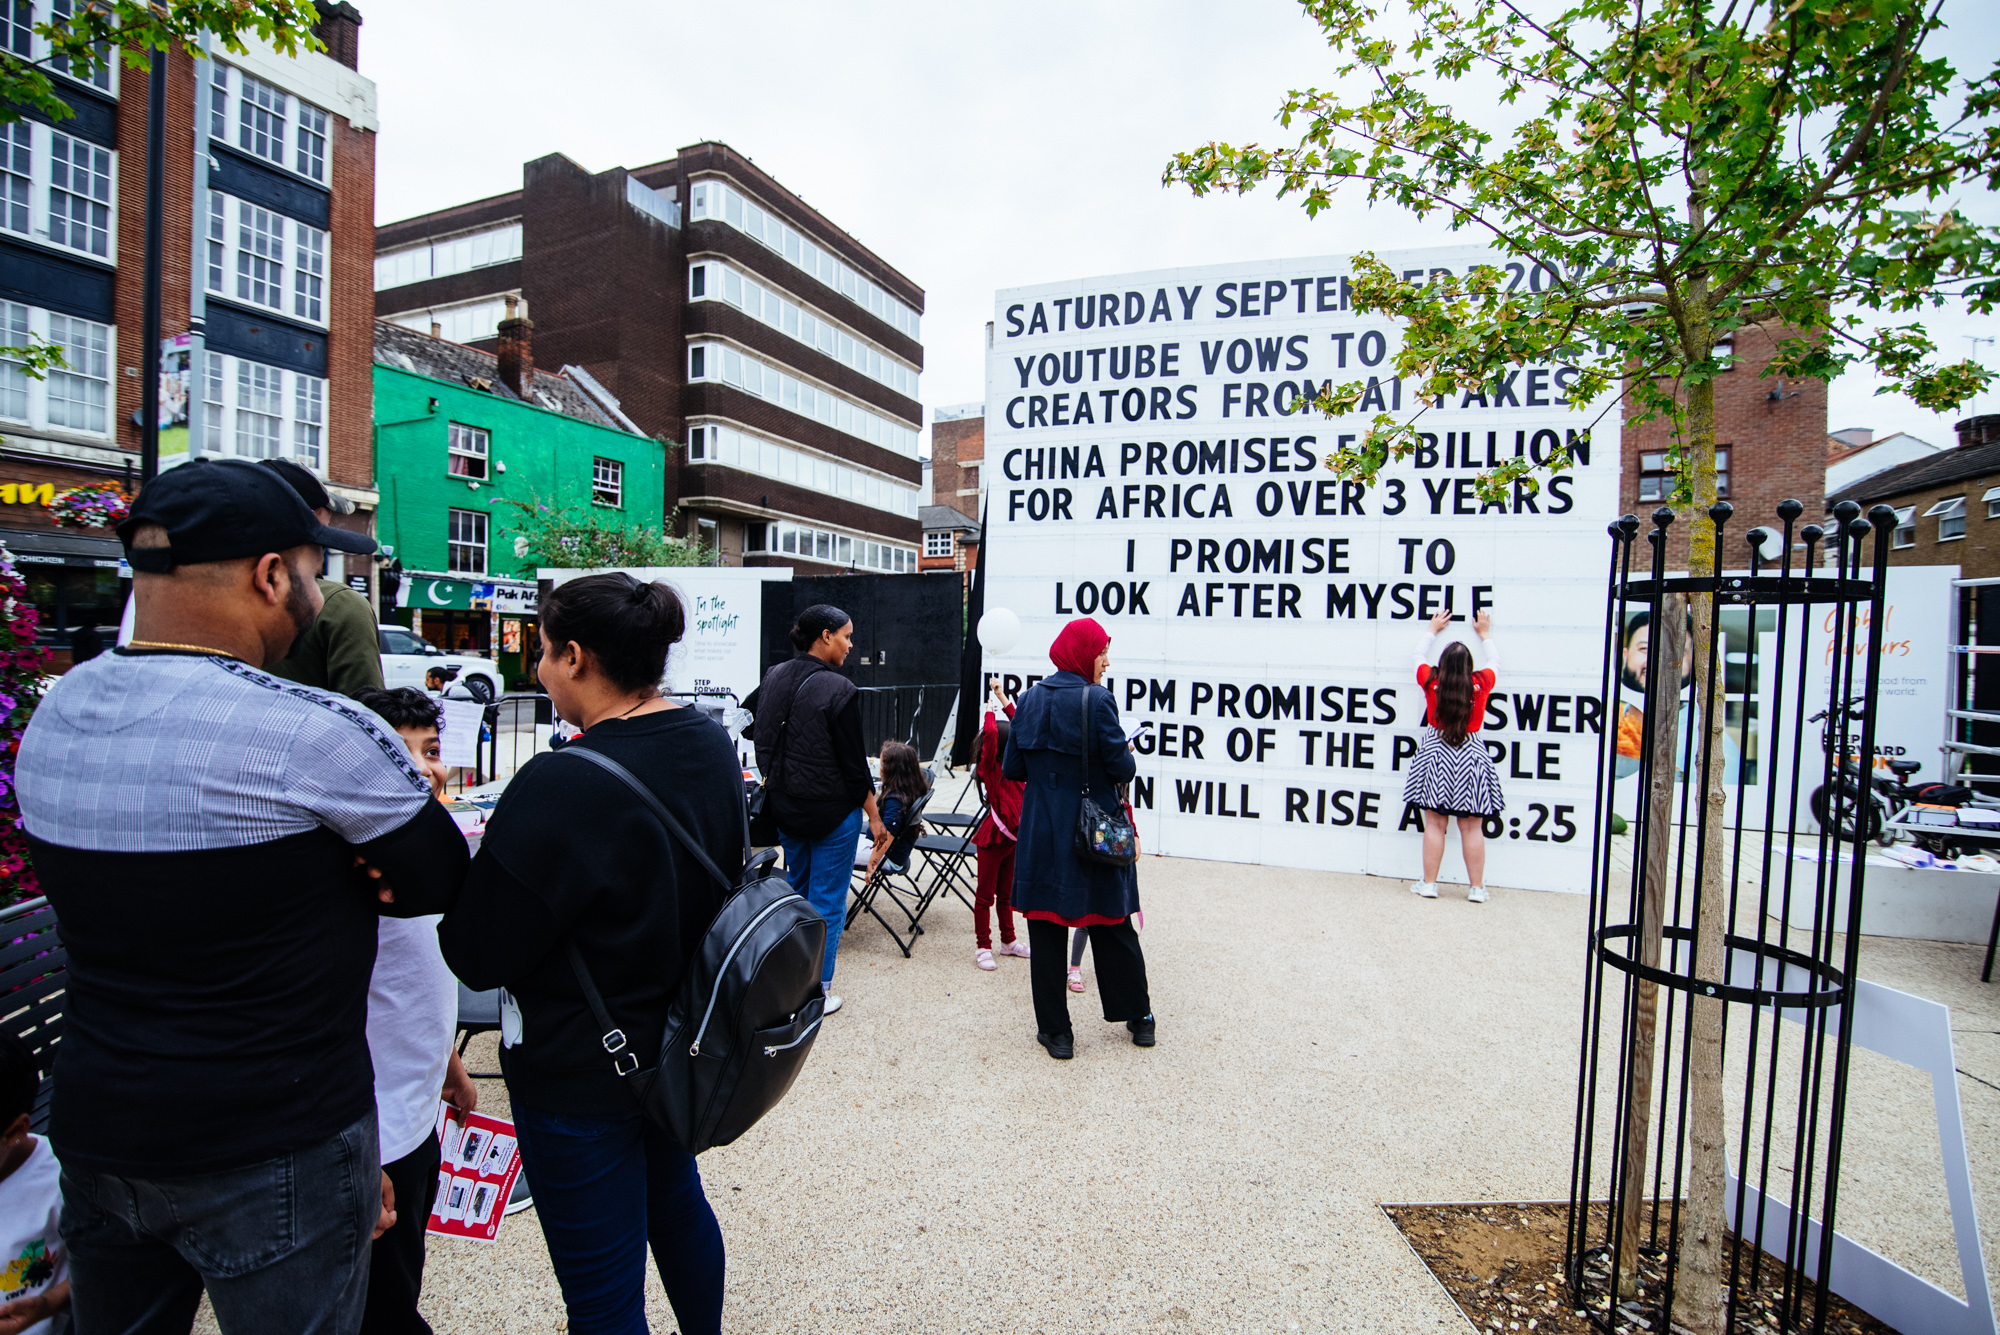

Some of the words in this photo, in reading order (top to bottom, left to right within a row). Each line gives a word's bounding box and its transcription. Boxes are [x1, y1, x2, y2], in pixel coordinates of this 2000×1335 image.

[1005, 285, 1203, 338] SATURDAY
[1215, 267, 1454, 319] SEPTEER
[1014, 343, 1180, 388] YOUTUBE
[1200, 335, 1309, 375] VOWS
[1331, 329, 1387, 369] TO
[1005, 384, 1198, 429] CREATORS
[1222, 379, 1333, 417] FROM
[1360, 374, 1401, 412] AI
[1436, 366, 1580, 410] AKES
[1003, 444, 1106, 482] CHINA
[1120, 434, 1318, 476] PROMISES
[1414, 427, 1592, 469] BILLION
[1009, 485, 1073, 522] FOR
[1096, 483, 1234, 520] AFRICA
[1256, 479, 1367, 517] OVER
[1382, 478, 1407, 516] 3
[1126, 538, 1135, 573] I
[1170, 536, 1350, 574] PROMISE
[1398, 537, 1457, 576] TO
[496, 588, 519, 600] Pak
[711, 594, 726, 611] the
[1055, 581, 1151, 616] LOOK
[1176, 582, 1302, 619] AFTER
[1326, 582, 1494, 623] MYSELF
[696, 613, 740, 637] spotlight
[1126, 678, 1176, 713] PM
[1191, 684, 1397, 725] PROMISES
[1227, 726, 1276, 763] OF
[1299, 730, 1375, 770] THE
[1392, 734, 1561, 781] PPLE
[1176, 778, 1260, 818] WILL
[1286, 786, 1382, 829] RISE
